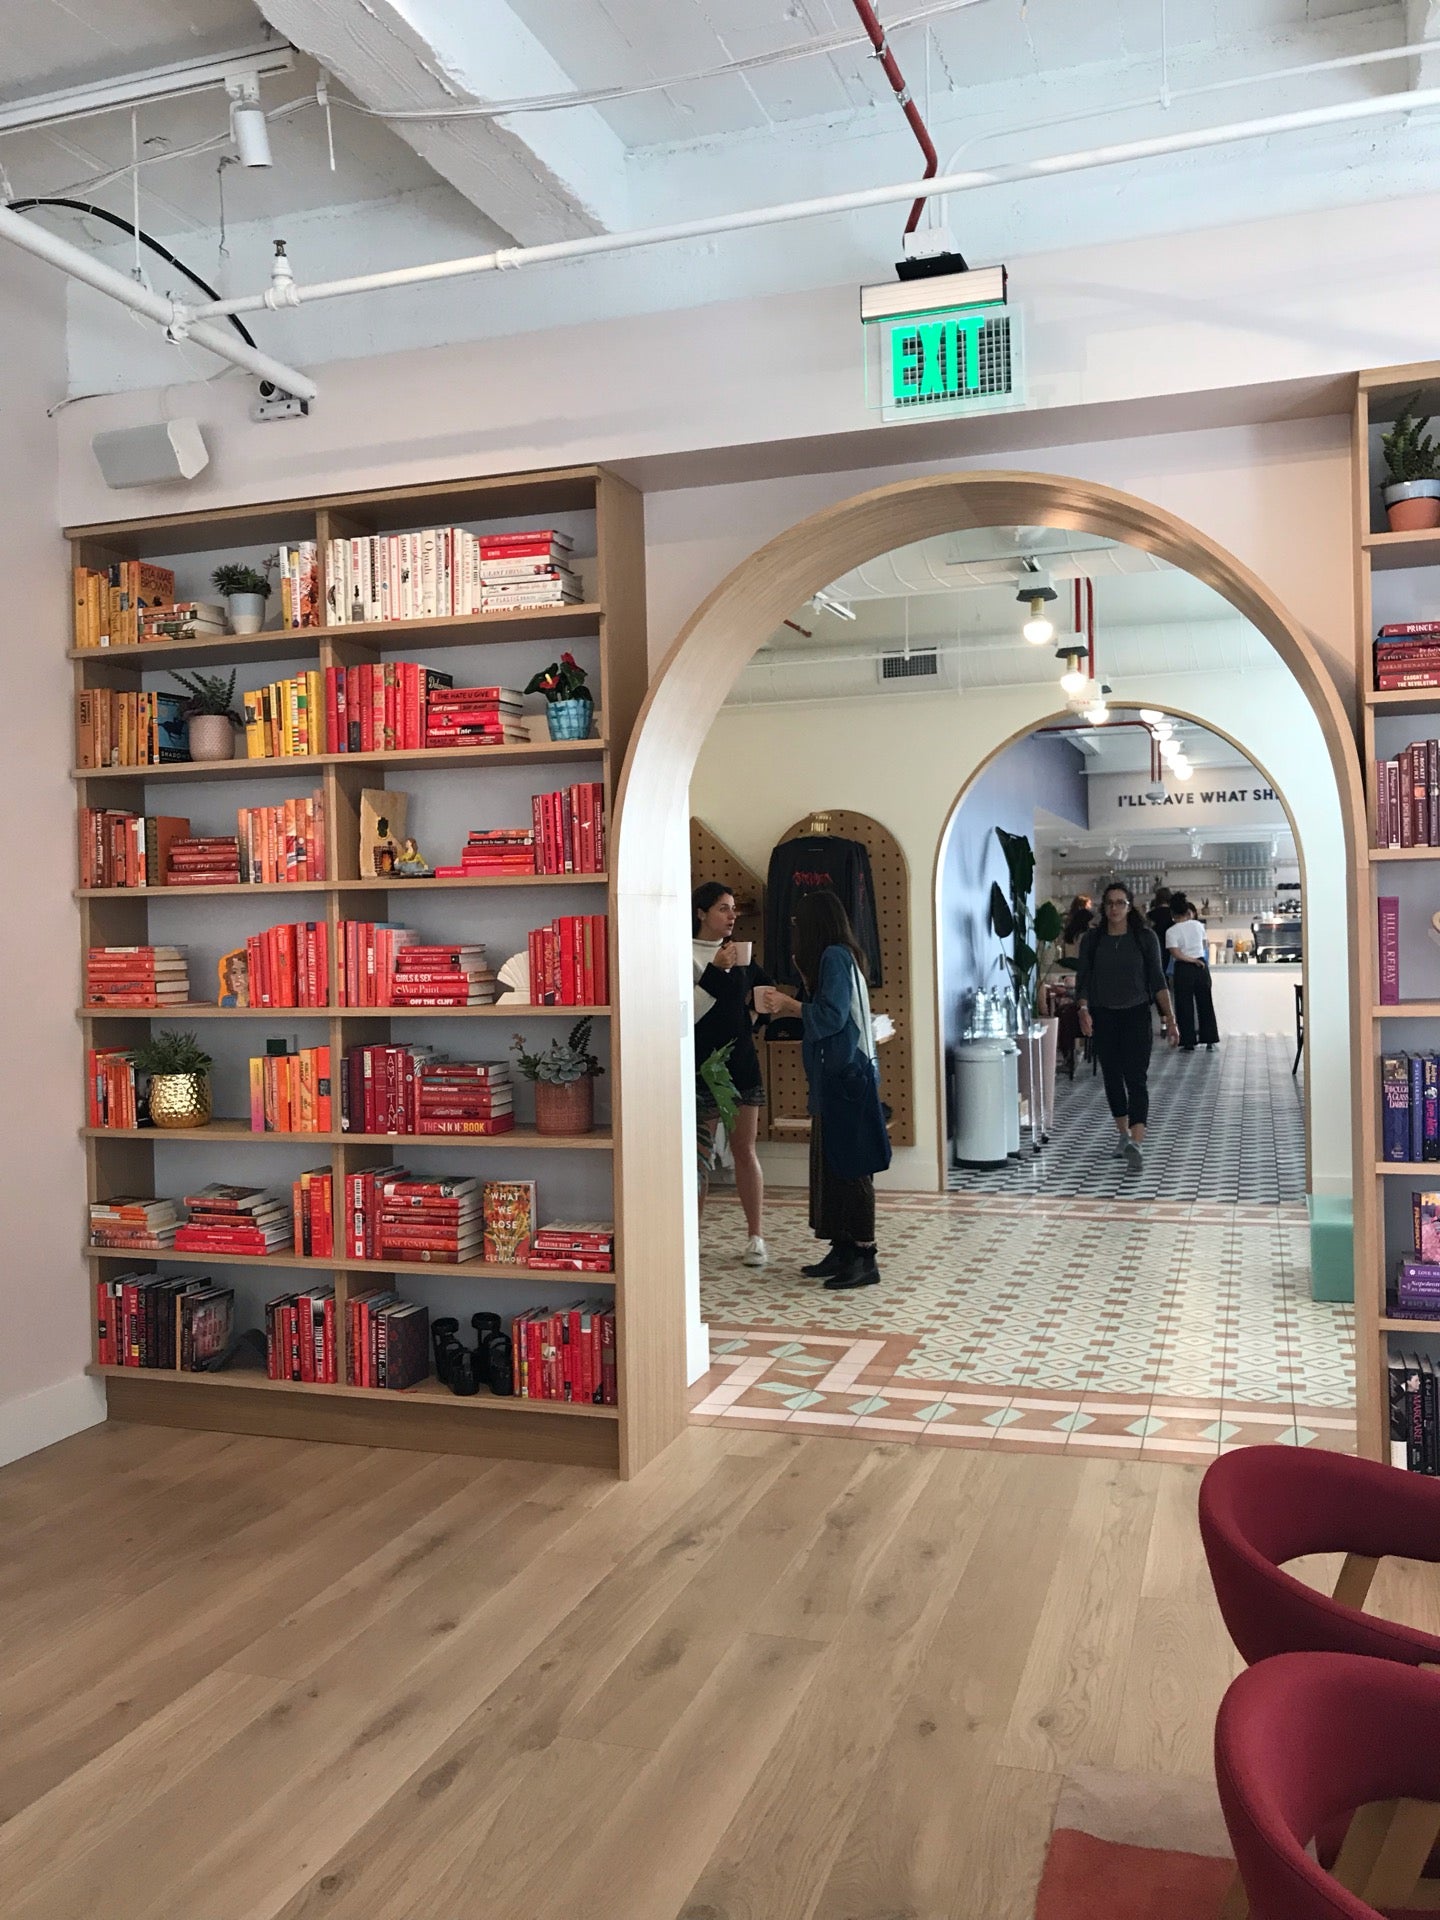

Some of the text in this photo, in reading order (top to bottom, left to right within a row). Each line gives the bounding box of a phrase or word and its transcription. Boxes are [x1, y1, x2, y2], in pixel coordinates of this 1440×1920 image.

[891, 315, 985, 398] EXIT
[422, 540, 435, 575] Oprah
[141, 577, 173, 595] BROWN
[1406, 623, 1433, 633] PRINCE
[430, 727, 472, 736] Sharon Tate
[1118, 795, 1146, 807] I'LL
[1200, 790, 1247, 803] WHAT
[1387, 913, 1396, 984] HILLA REBAY
[396, 974, 413, 983] GIRLS
[420, 973, 433, 982] SEX
[402, 984, 440, 994] War Paint
[387, 1055, 398, 1127] AMY TAN
[1392, 1092, 1409, 1101] GLASS
[423, 1122, 437, 1132] THE
[463, 1122, 485, 1132] BOOK
[490, 1192, 519, 1201] WHAT
[497, 1206, 512, 1214] WE
[492, 1220, 518, 1229] LOSE
[403, 1240, 430, 1248] FONDA
[485, 1254, 528, 1265] CLEMMONS
[378, 1325, 386, 1348] TAKES
[603, 1321, 614, 1344] Liberty
[303, 1344, 311, 1368] george
[378, 1349, 386, 1363] ONE
[1412, 1394, 1423, 1446] MARGARET
